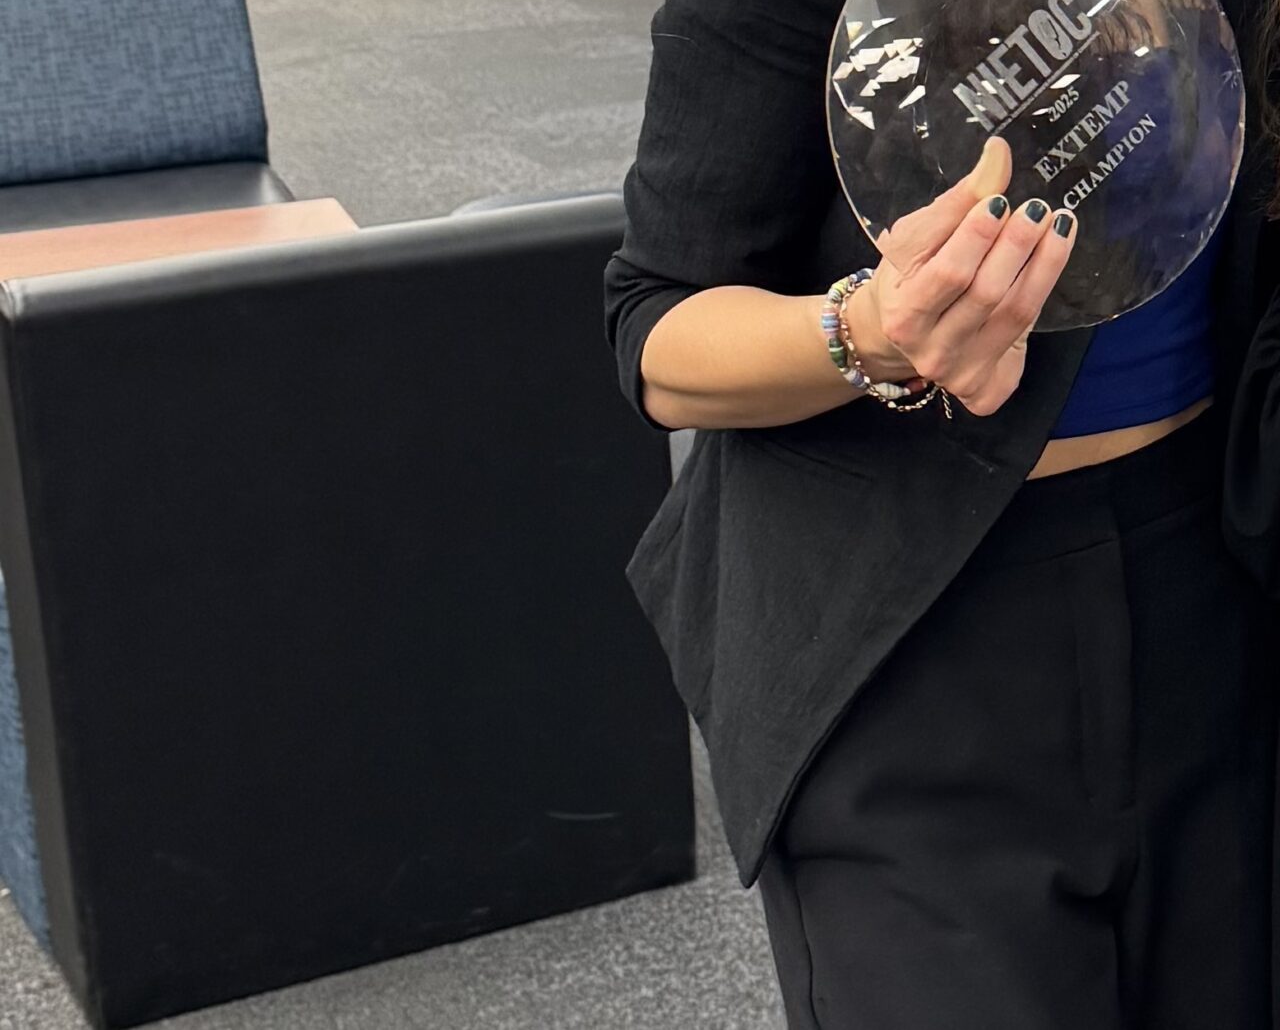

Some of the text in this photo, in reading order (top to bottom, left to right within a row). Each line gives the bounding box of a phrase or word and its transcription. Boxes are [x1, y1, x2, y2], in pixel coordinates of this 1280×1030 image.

[1033, 80, 1133, 184] EXTEMP
[1048, 88, 1080, 123] 2025
[1062, 113, 1158, 212] CHAMPION
